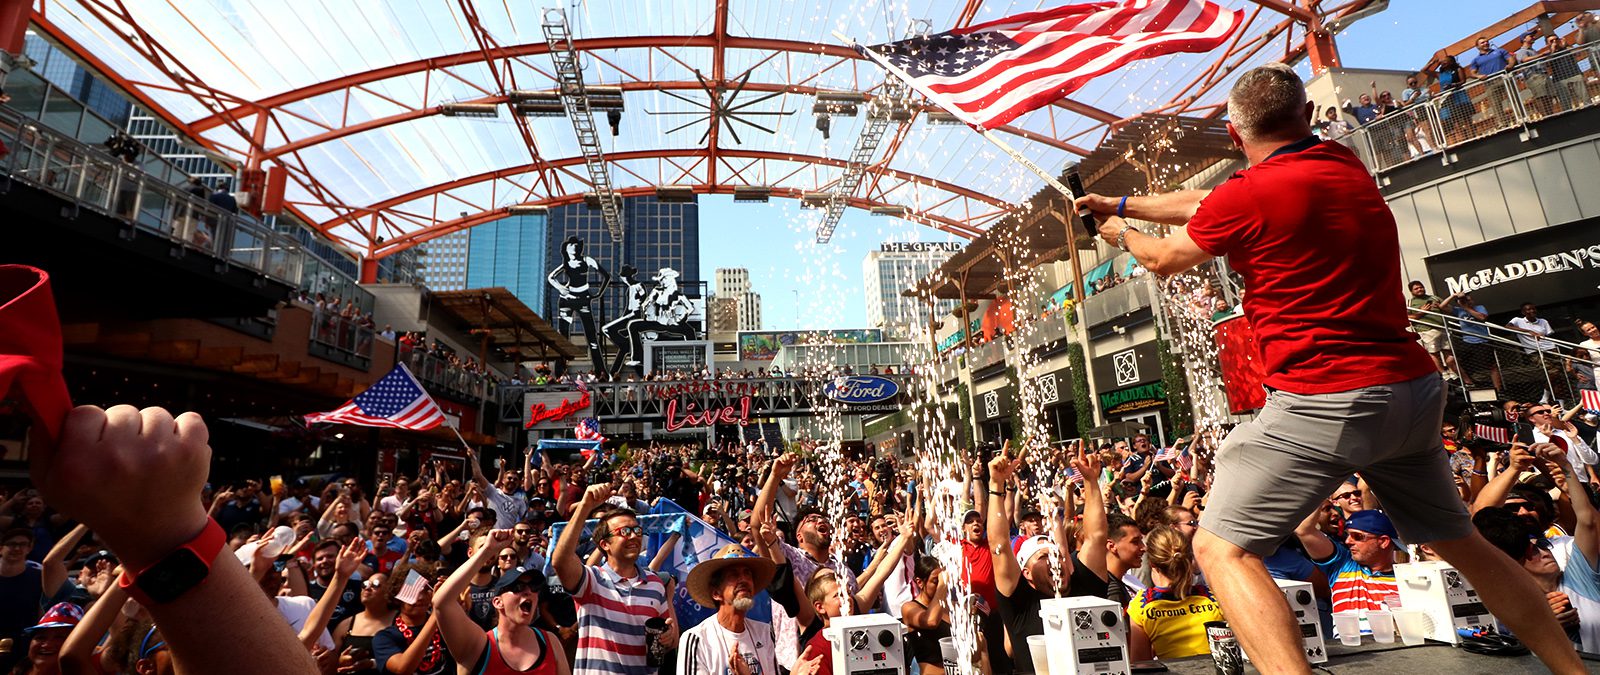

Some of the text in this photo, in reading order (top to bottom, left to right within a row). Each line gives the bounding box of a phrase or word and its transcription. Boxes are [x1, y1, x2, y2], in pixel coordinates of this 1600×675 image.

[881, 242, 962, 252] THE GRAND
[1445, 244, 1600, 296] McFADDEN'S
[658, 381, 720, 399] KANSAS
[837, 379, 885, 398] Ford
[666, 395, 750, 432] Live!
[1146, 604, 1214, 621] Corona Cero
